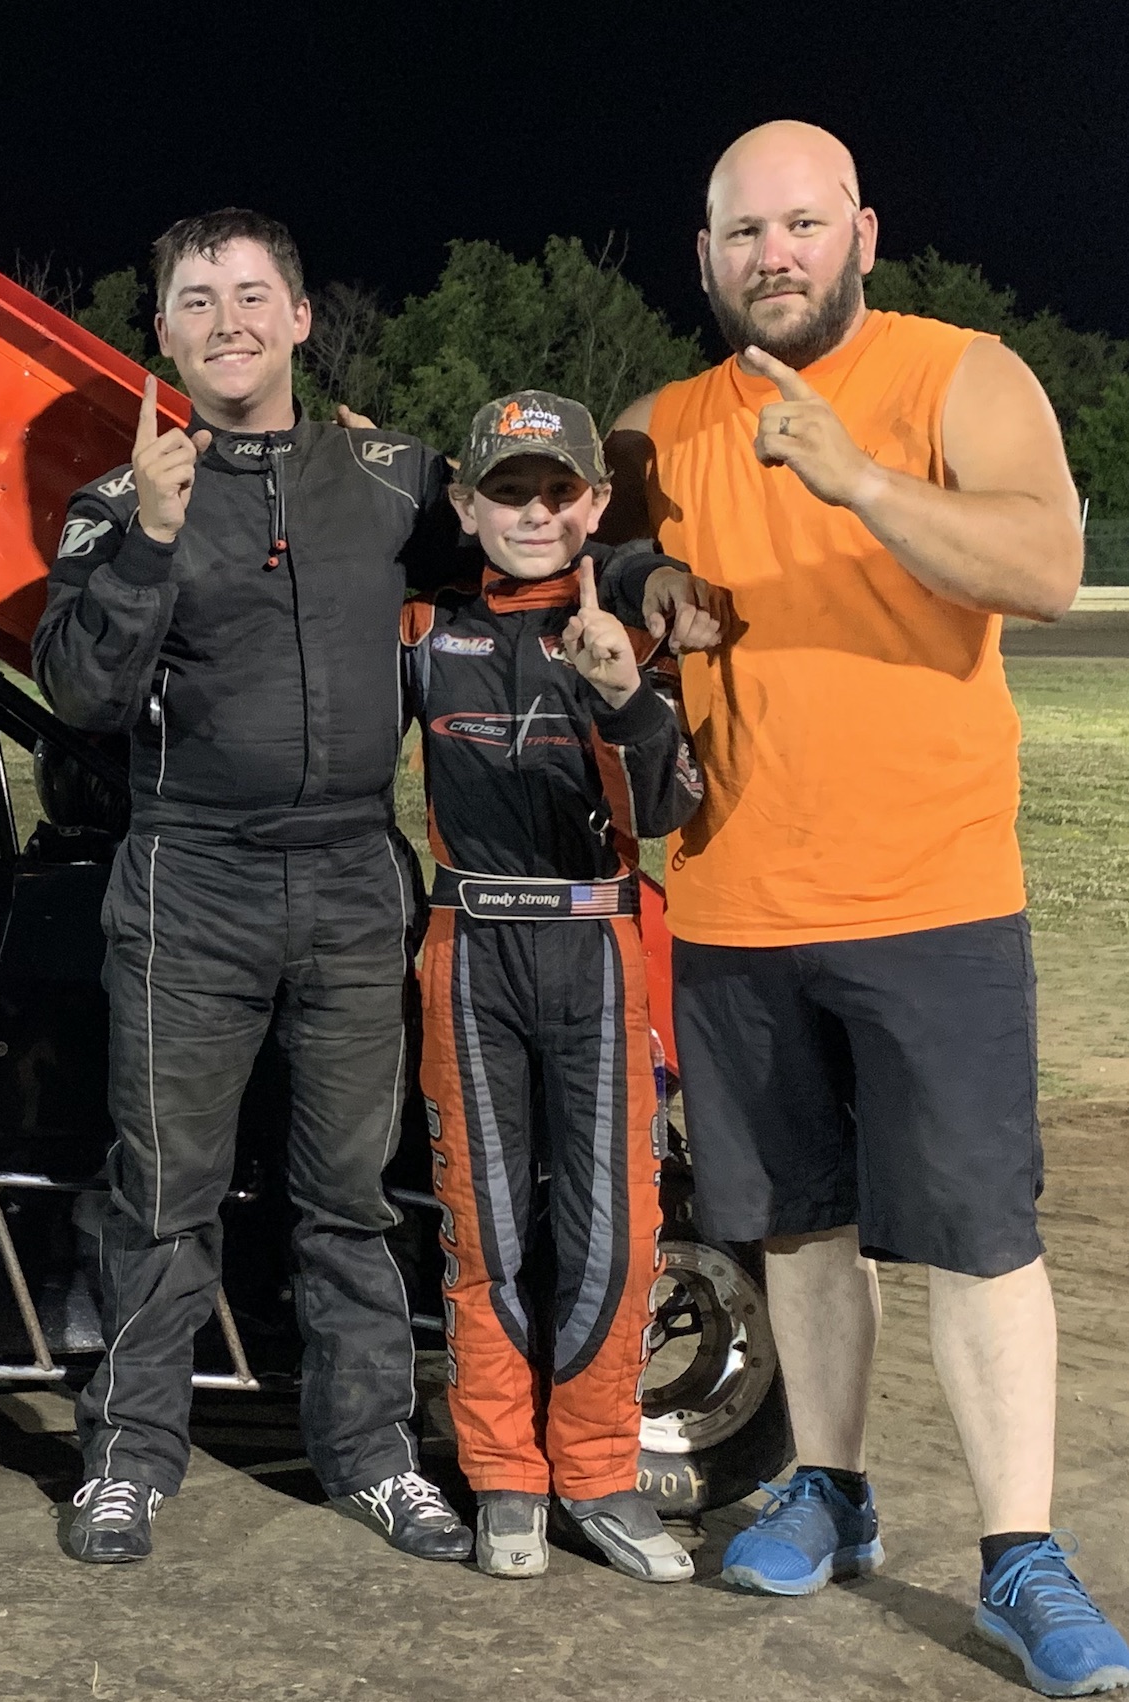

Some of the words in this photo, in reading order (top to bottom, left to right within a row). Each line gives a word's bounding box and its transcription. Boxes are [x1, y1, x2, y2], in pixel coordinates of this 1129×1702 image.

[449, 721, 508, 737] CROSS
[477, 892, 516, 906] Brody
[517, 892, 561, 907] Strong
